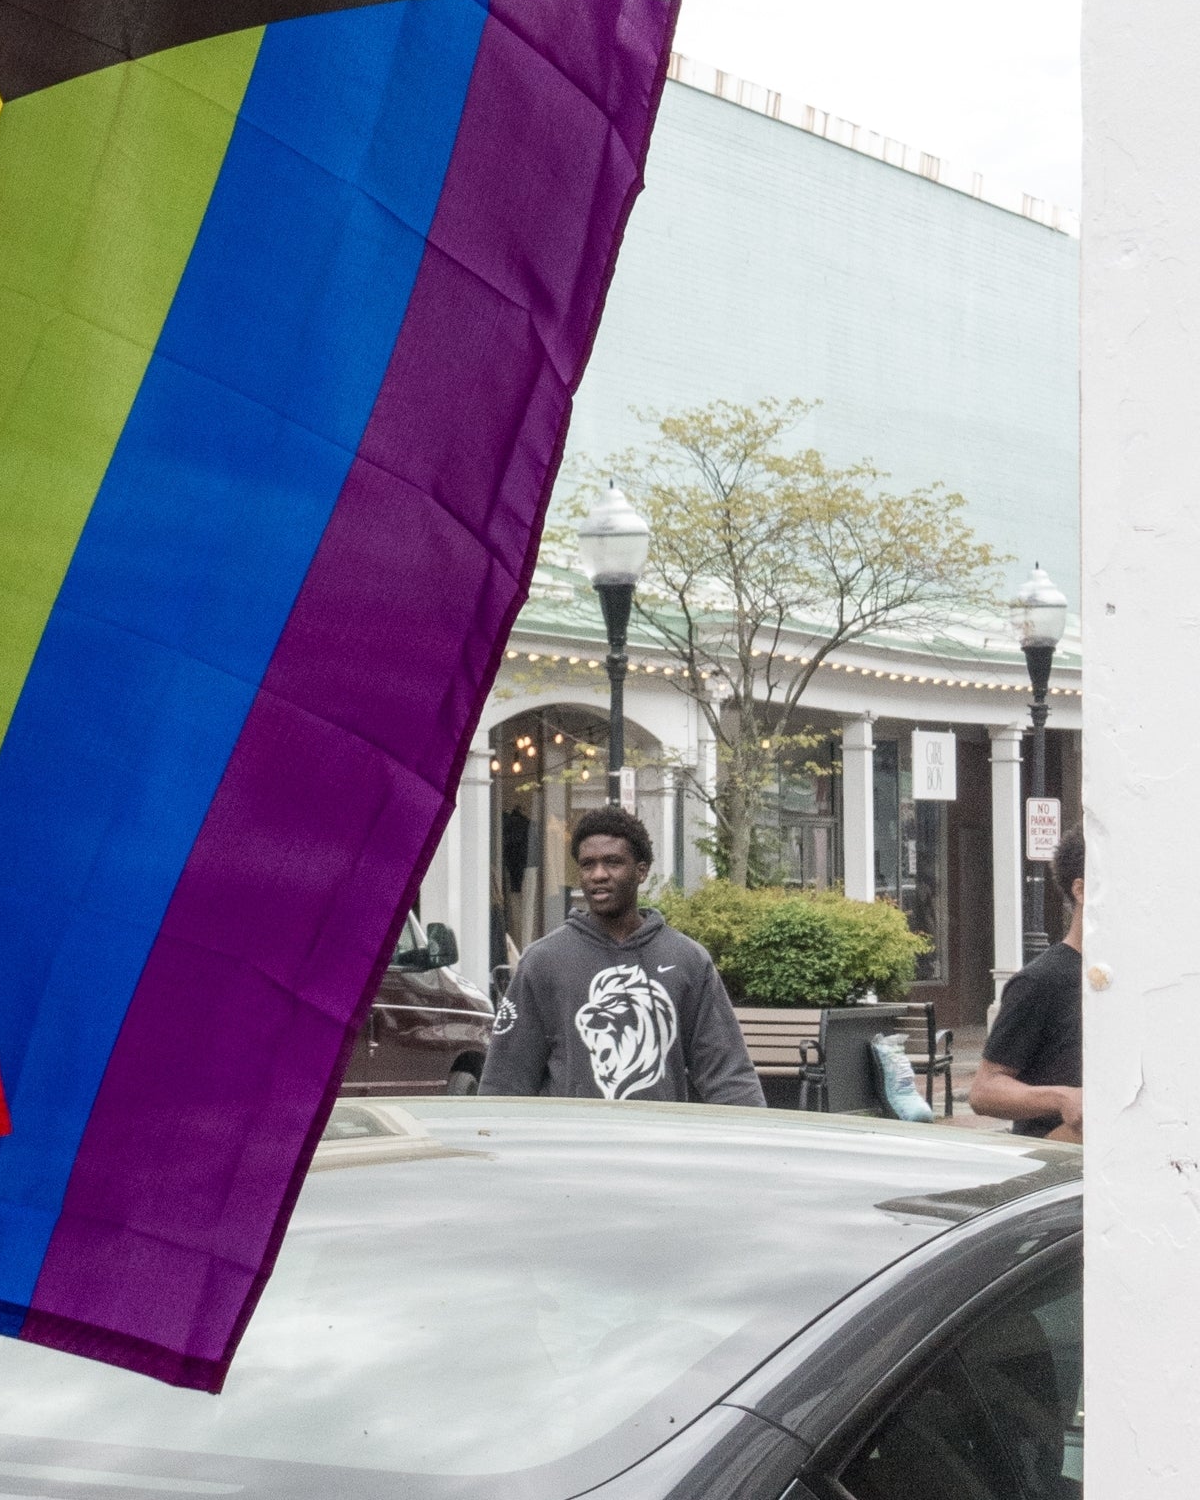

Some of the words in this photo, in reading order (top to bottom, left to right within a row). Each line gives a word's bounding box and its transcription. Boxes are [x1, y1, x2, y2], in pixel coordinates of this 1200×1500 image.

[926, 741, 944, 766] GIRL
[927, 766, 944, 791] BOY
[1037, 803, 1050, 815] NO
[1031, 815, 1057, 827] PARKING
[1031, 828, 1057, 836] BETWEEN
